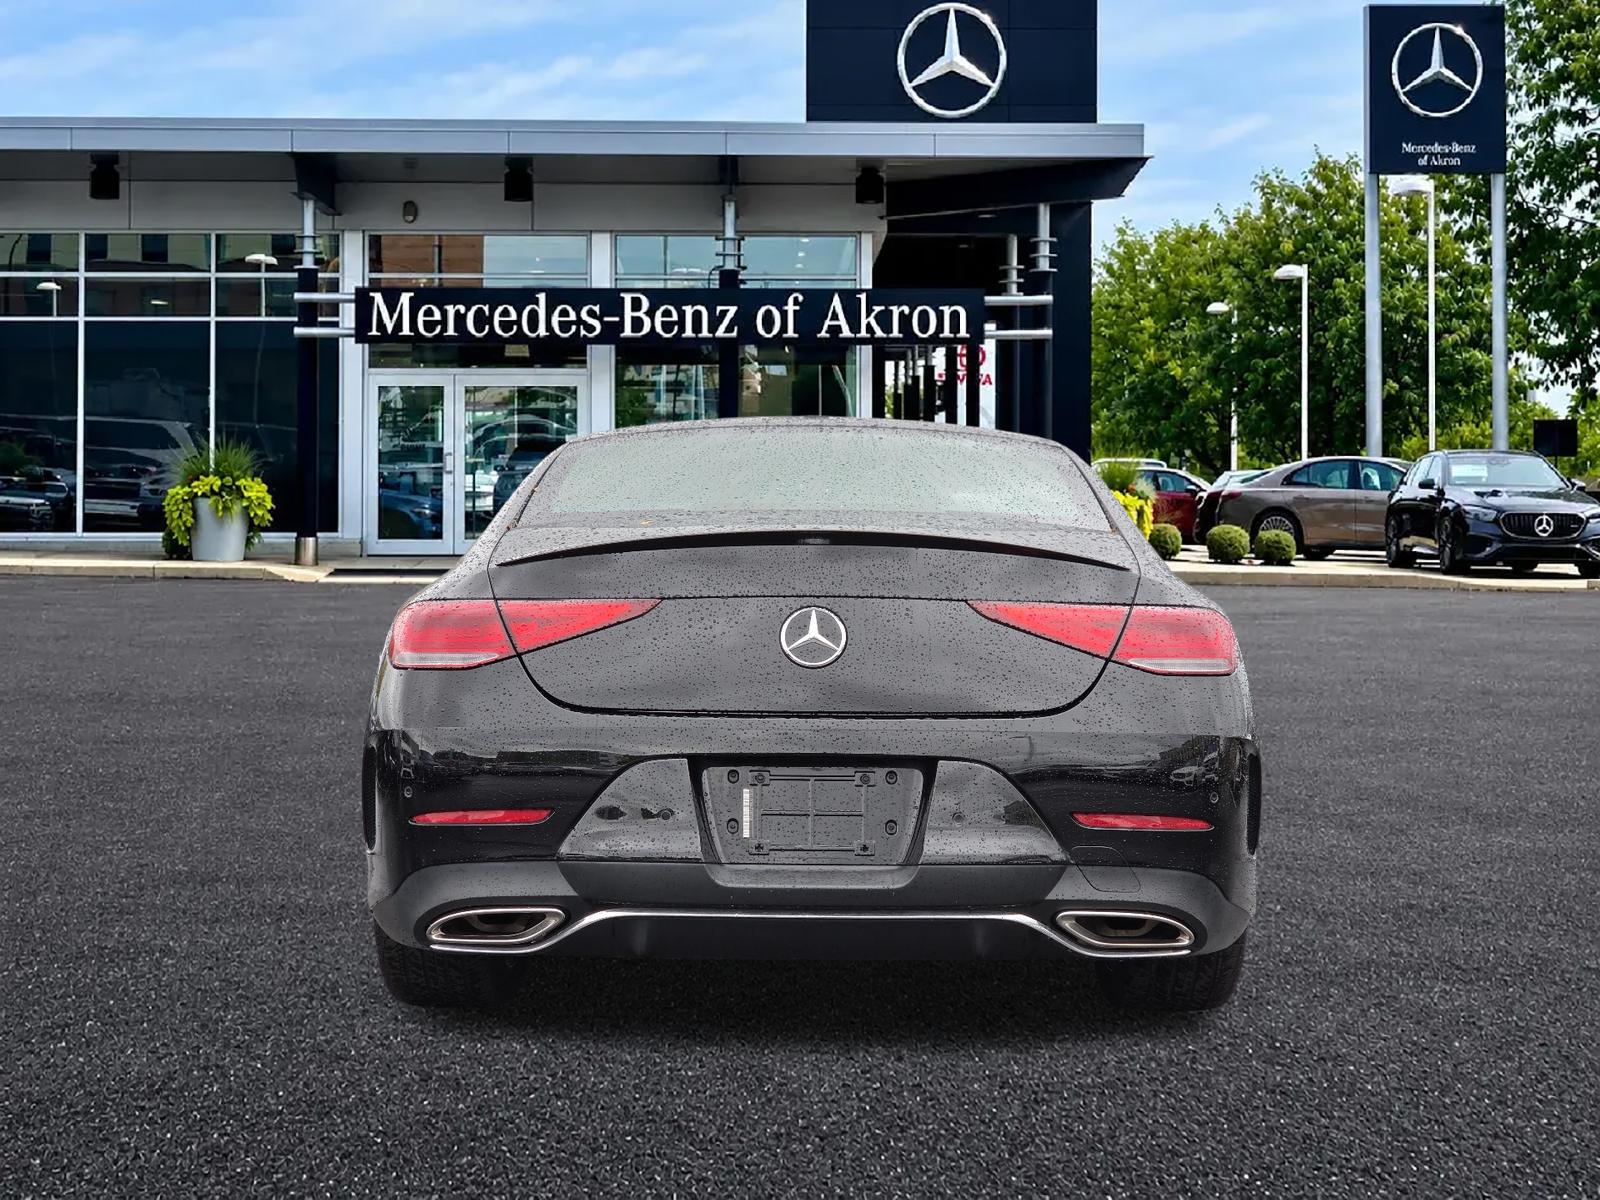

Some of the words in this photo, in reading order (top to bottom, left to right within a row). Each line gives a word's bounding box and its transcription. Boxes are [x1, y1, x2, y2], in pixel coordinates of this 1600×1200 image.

[1401, 141, 1477, 153] Mercedes-Benz
[1417, 154, 1429, 166] of
[1430, 154, 1461, 166] Akron
[367, 291, 738, 338] Mercedes-Benz
[755, 292, 804, 338] of
[816, 291, 971, 338] Akron
